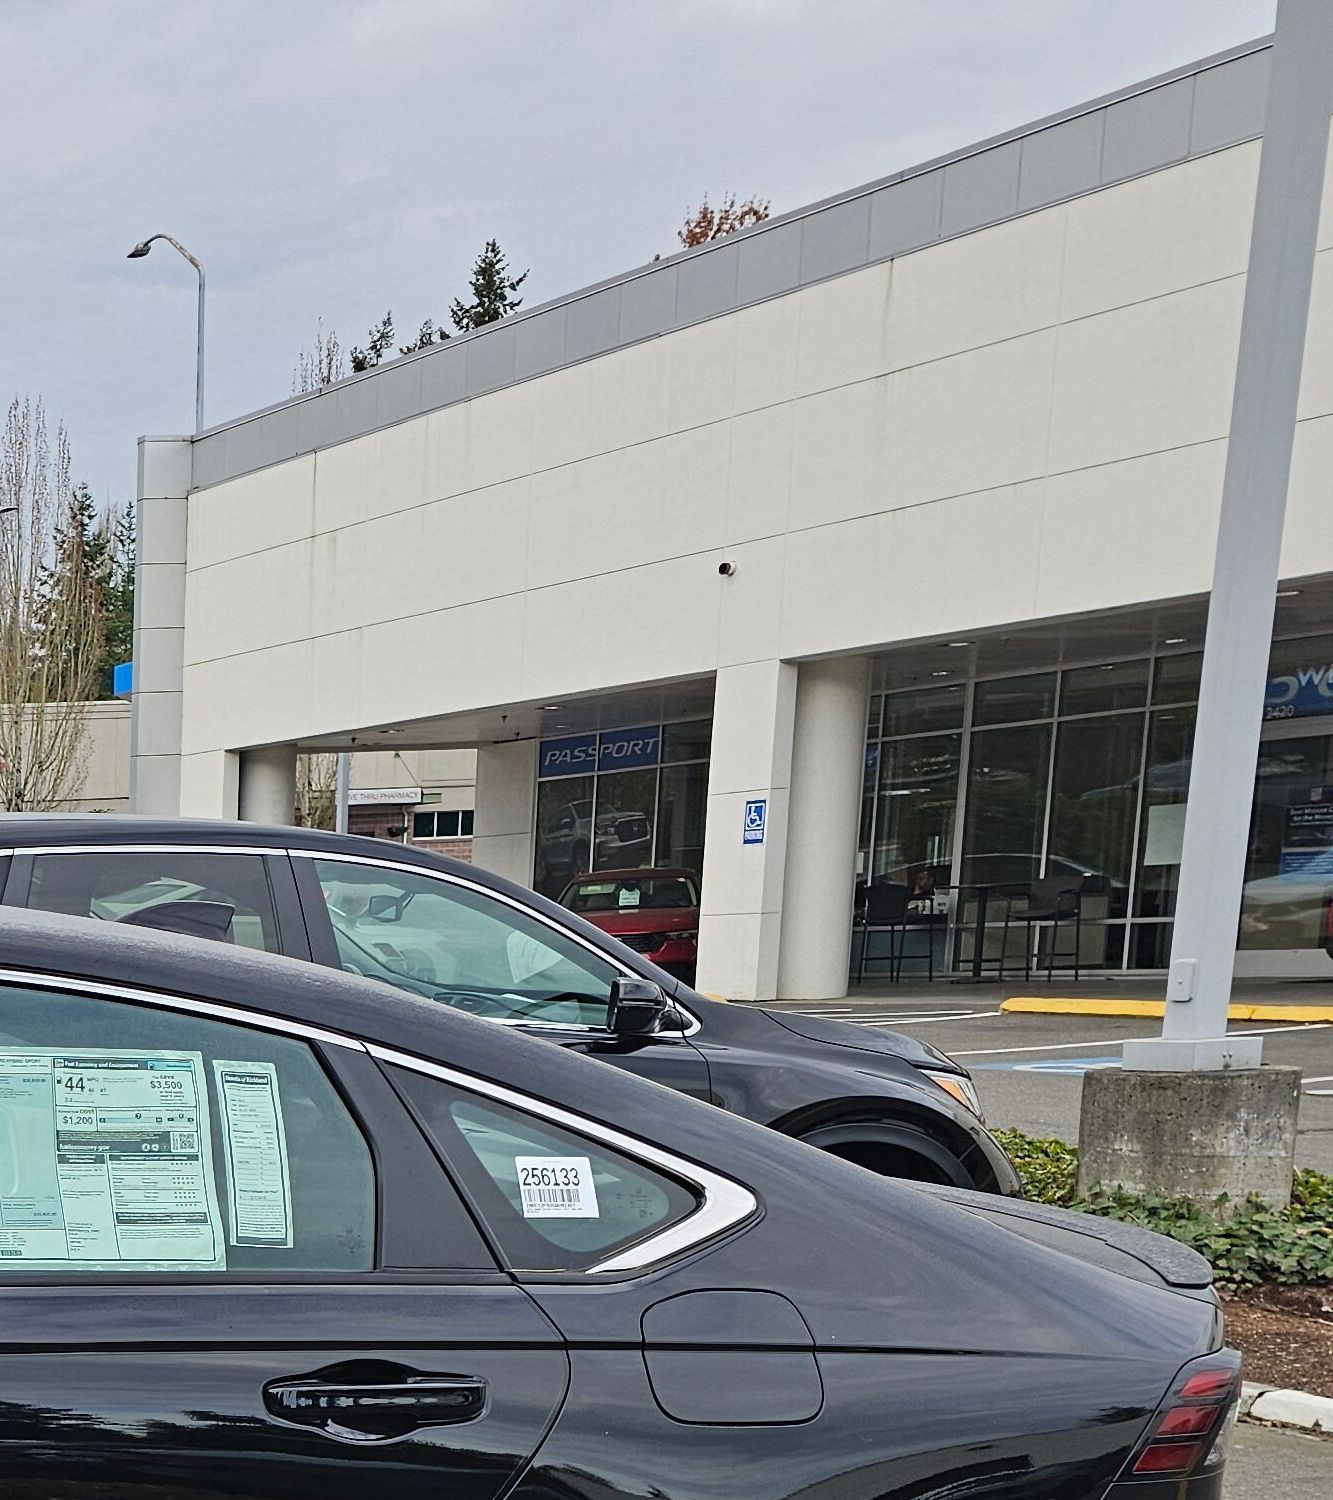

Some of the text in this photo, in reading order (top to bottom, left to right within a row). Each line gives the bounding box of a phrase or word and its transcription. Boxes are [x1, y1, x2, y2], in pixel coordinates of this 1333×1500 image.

[544, 737, 660, 766] PASSPORT
[64, 1076, 85, 1092] 44
[150, 1080, 183, 1090] $3,500
[62, 1116, 93, 1125] $1,200
[520, 1167, 580, 1187] 256133
